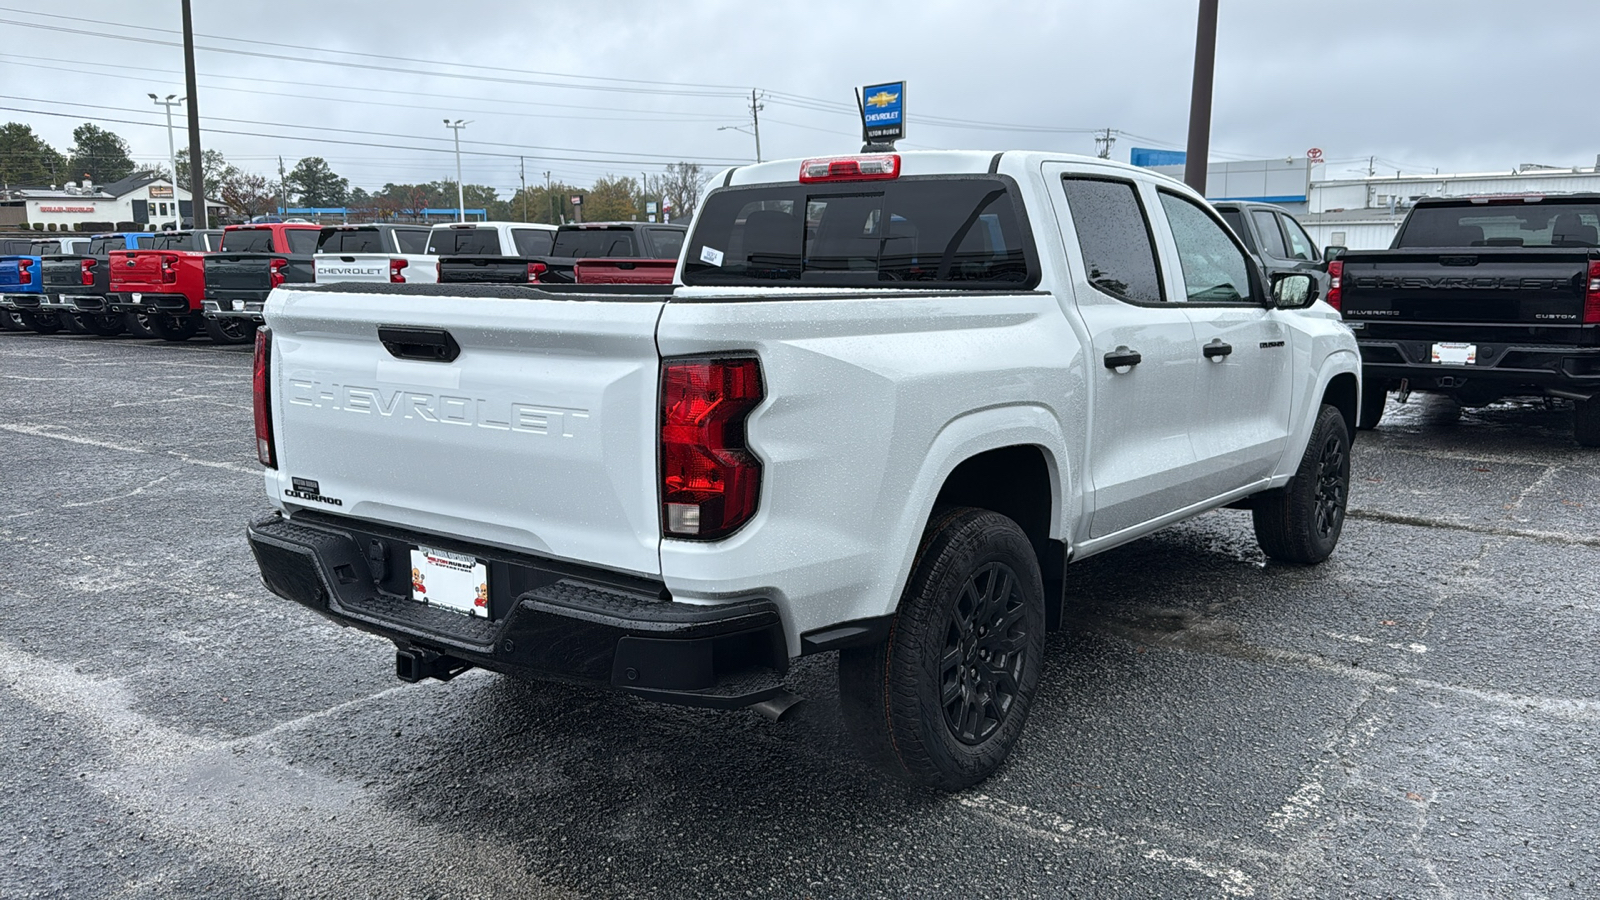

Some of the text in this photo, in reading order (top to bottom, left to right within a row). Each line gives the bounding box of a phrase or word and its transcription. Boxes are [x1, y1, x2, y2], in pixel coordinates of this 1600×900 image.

[865, 111, 899, 121] CHEVROLET
[1356, 277, 1567, 290] CHEVROLET
[289, 378, 589, 437] CHEVROLET
[284, 489, 342, 506] COLORADO
[448, 560, 472, 569] RUBEN
